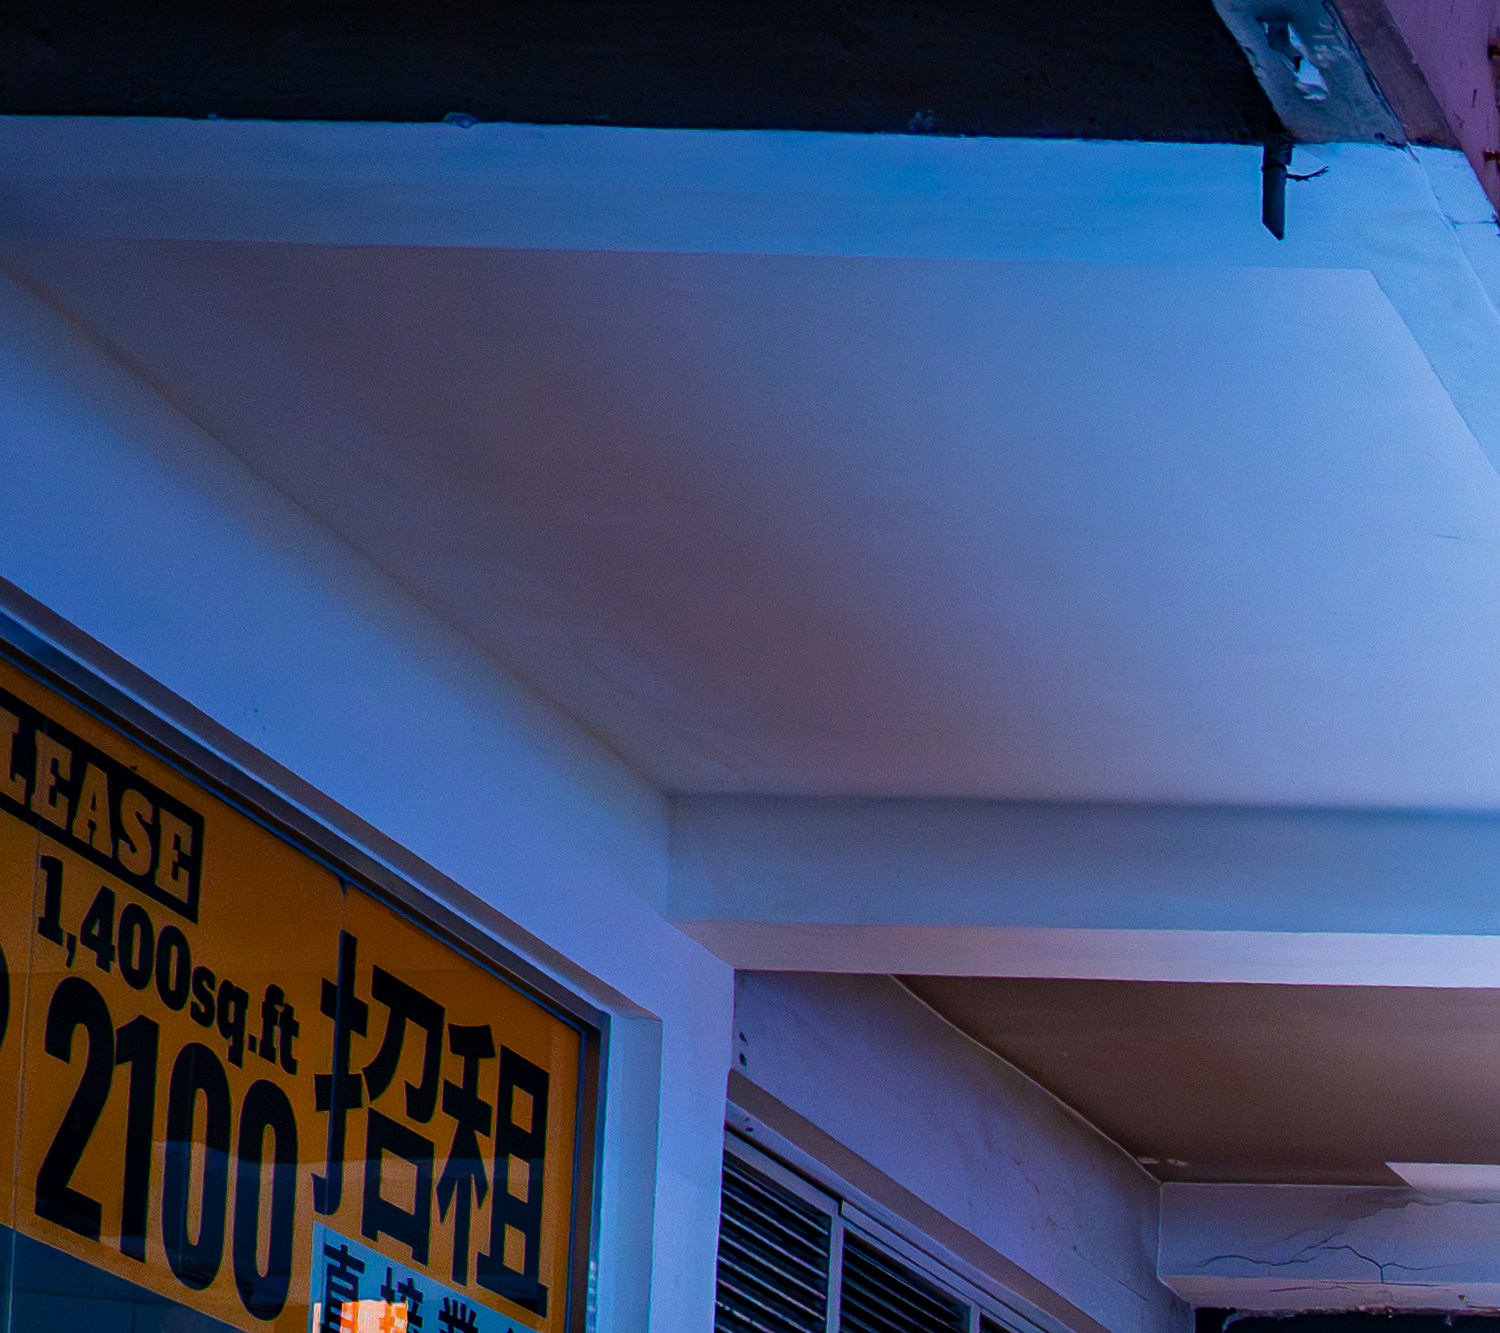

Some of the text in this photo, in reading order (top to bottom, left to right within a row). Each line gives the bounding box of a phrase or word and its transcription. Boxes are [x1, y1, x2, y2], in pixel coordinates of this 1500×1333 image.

[36, 855, 301, 1075] 1,400sq.ft
[313, 929, 549, 1319] 招租
[34, 977, 300, 1322] 2100
